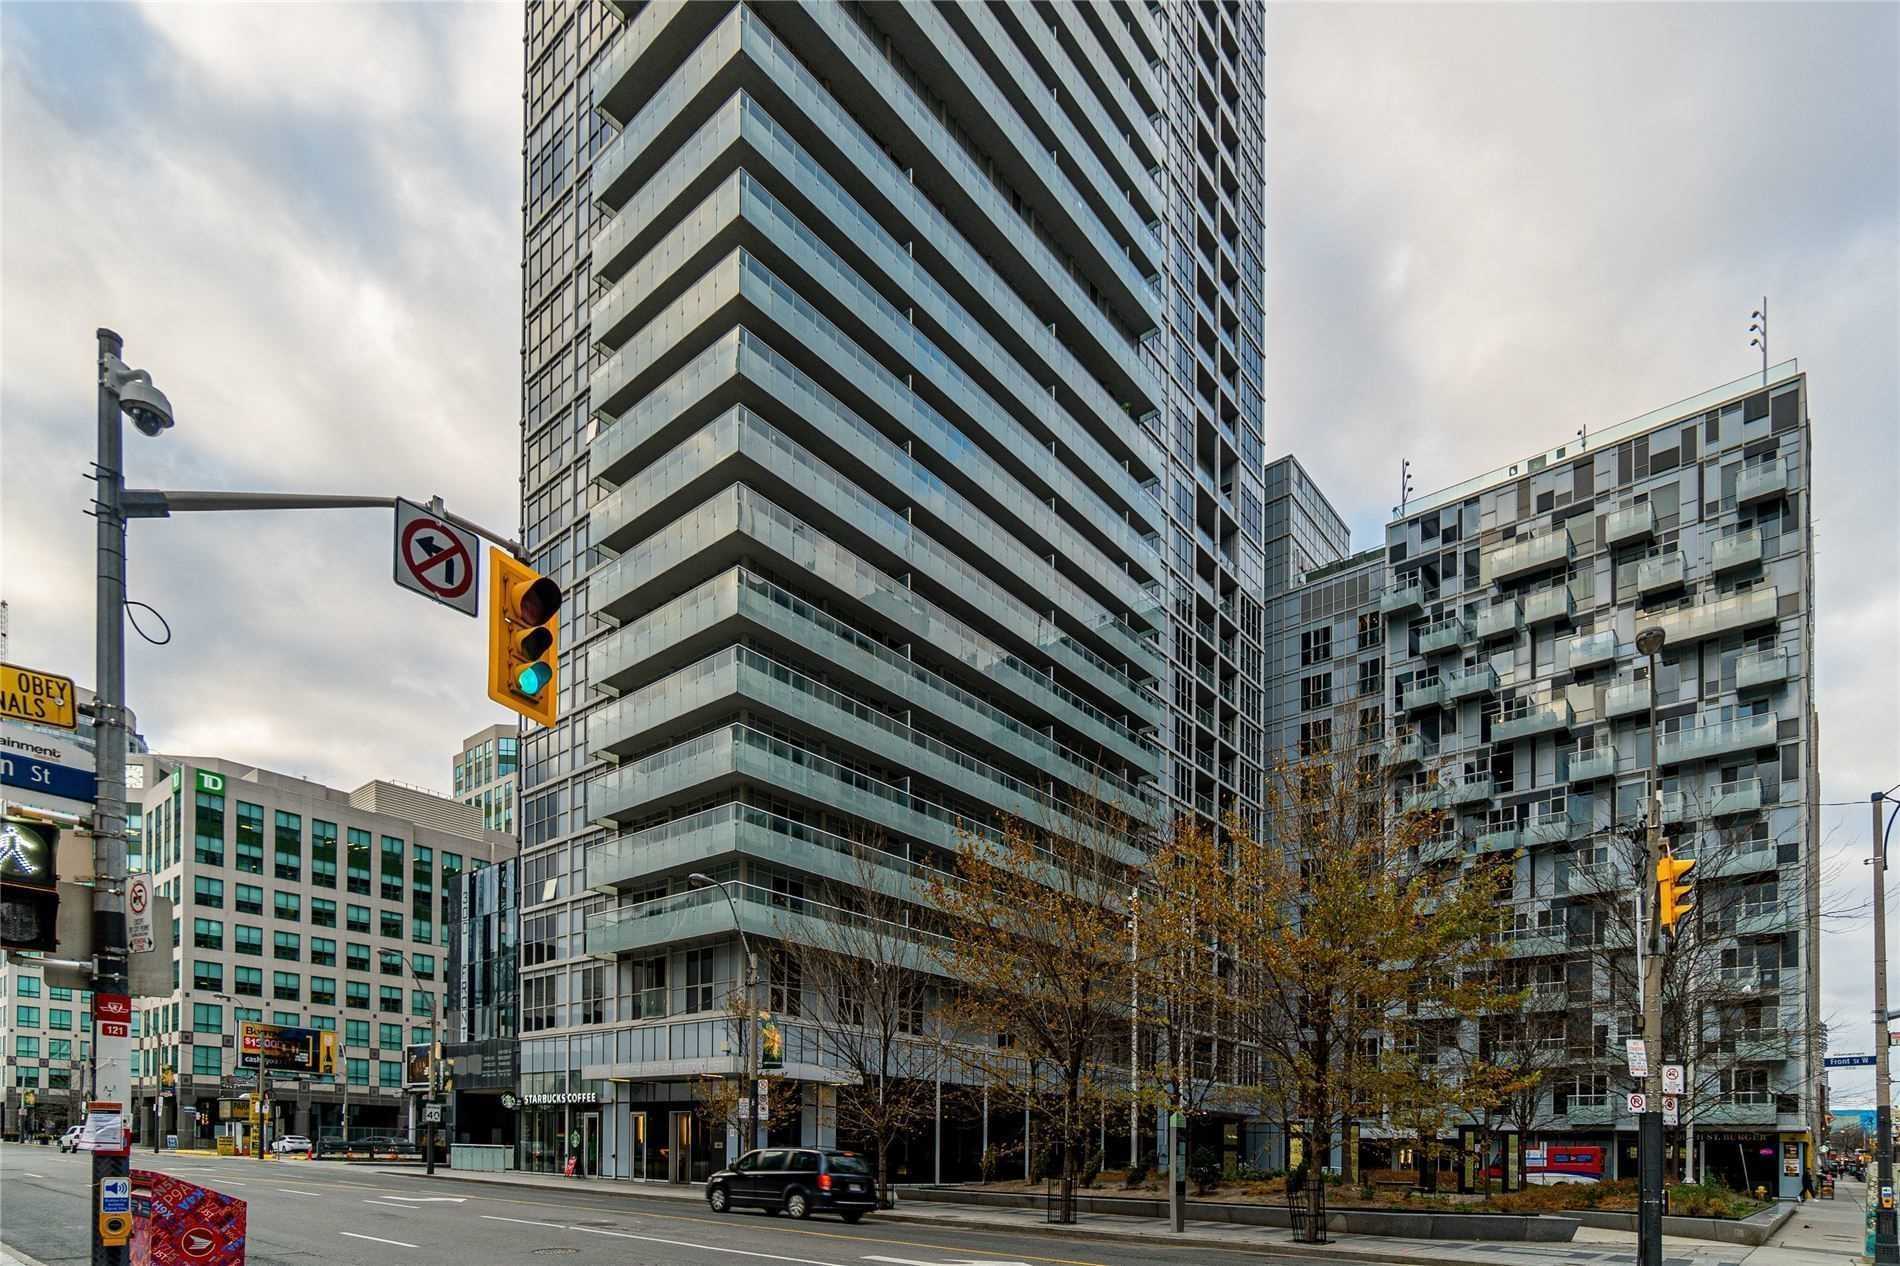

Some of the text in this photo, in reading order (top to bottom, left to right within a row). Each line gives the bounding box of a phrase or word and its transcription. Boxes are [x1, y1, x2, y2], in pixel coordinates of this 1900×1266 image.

[18, 672, 67, 700] OBEY
[31, 765, 51, 785] St
[199, 772, 223, 791] TD
[106, 1025, 124, 1036] 121
[524, 1092, 596, 1105] STARBUCKS COFFEE
[426, 1111, 440, 1120] 40
